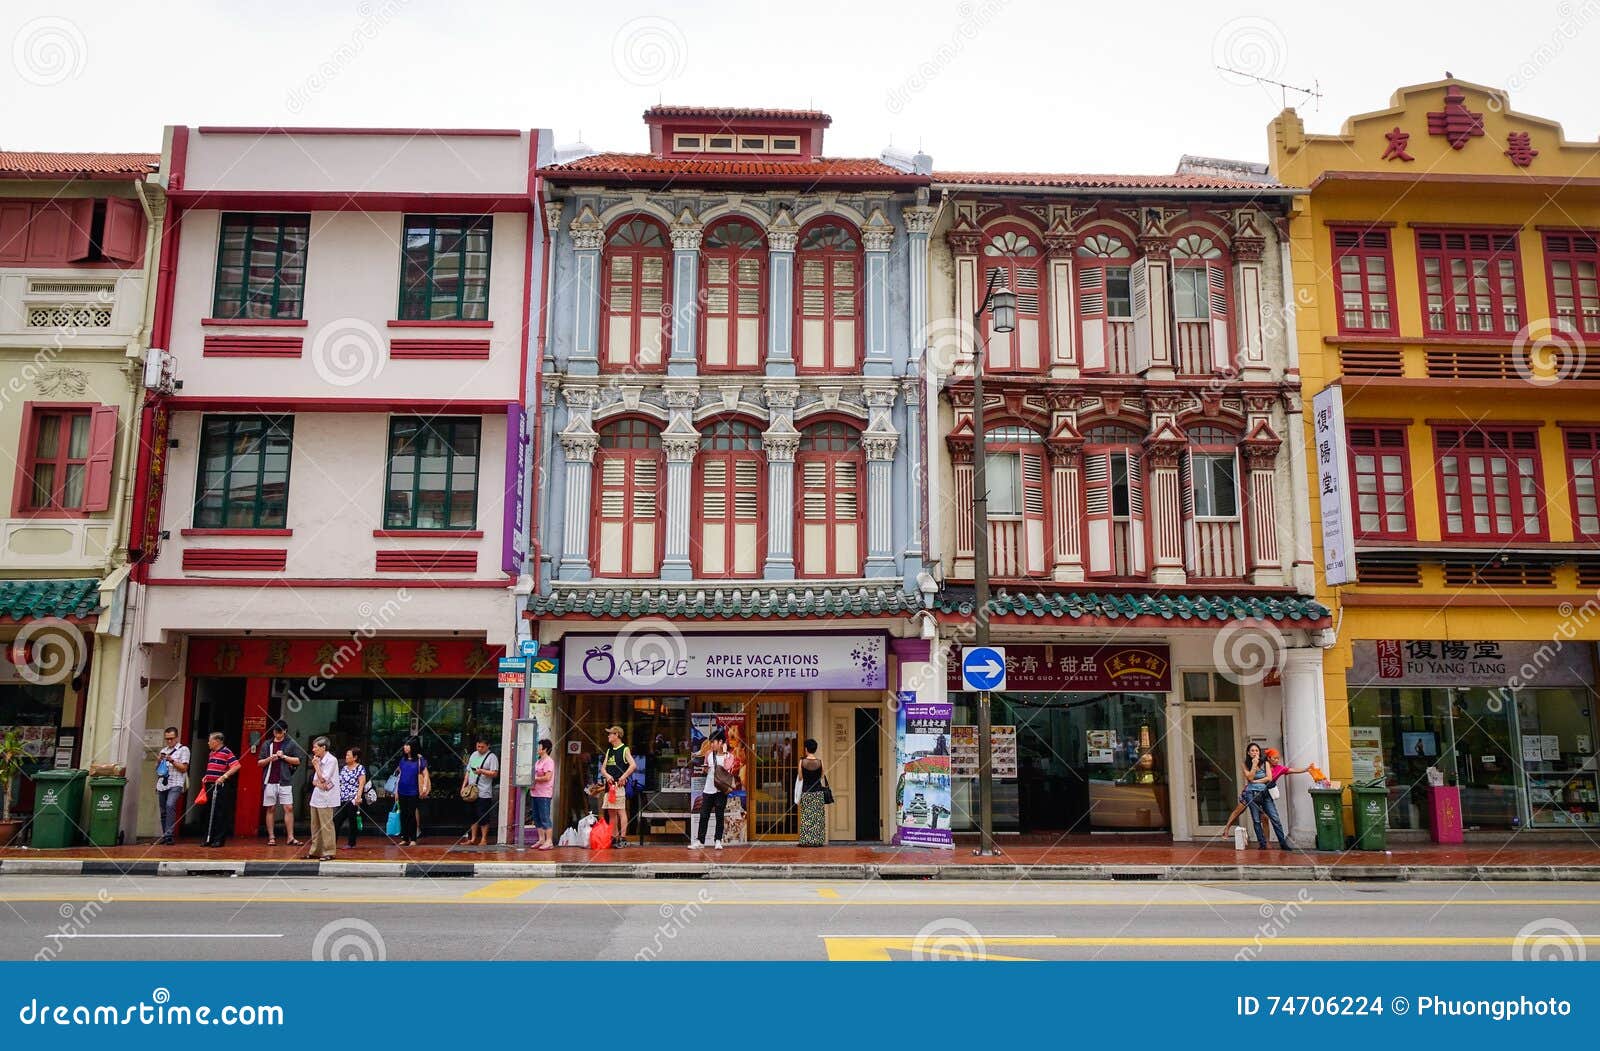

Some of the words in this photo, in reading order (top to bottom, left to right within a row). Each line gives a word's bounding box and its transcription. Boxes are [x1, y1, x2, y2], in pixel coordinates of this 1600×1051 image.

[1381, 127, 1415, 161] 友
[1504, 131, 1539, 167] 善
[1405, 640, 1503, 659] 復陽堂
[618, 658, 688, 676] APPLE
[706, 655, 743, 665] APPLE
[747, 655, 819, 665] VACATIONS
[1060, 656, 1097, 673] 甜品
[706, 668, 774, 678] SINGAPORE
[777, 668, 796, 678] PTE
[800, 668, 819, 678] LTD
